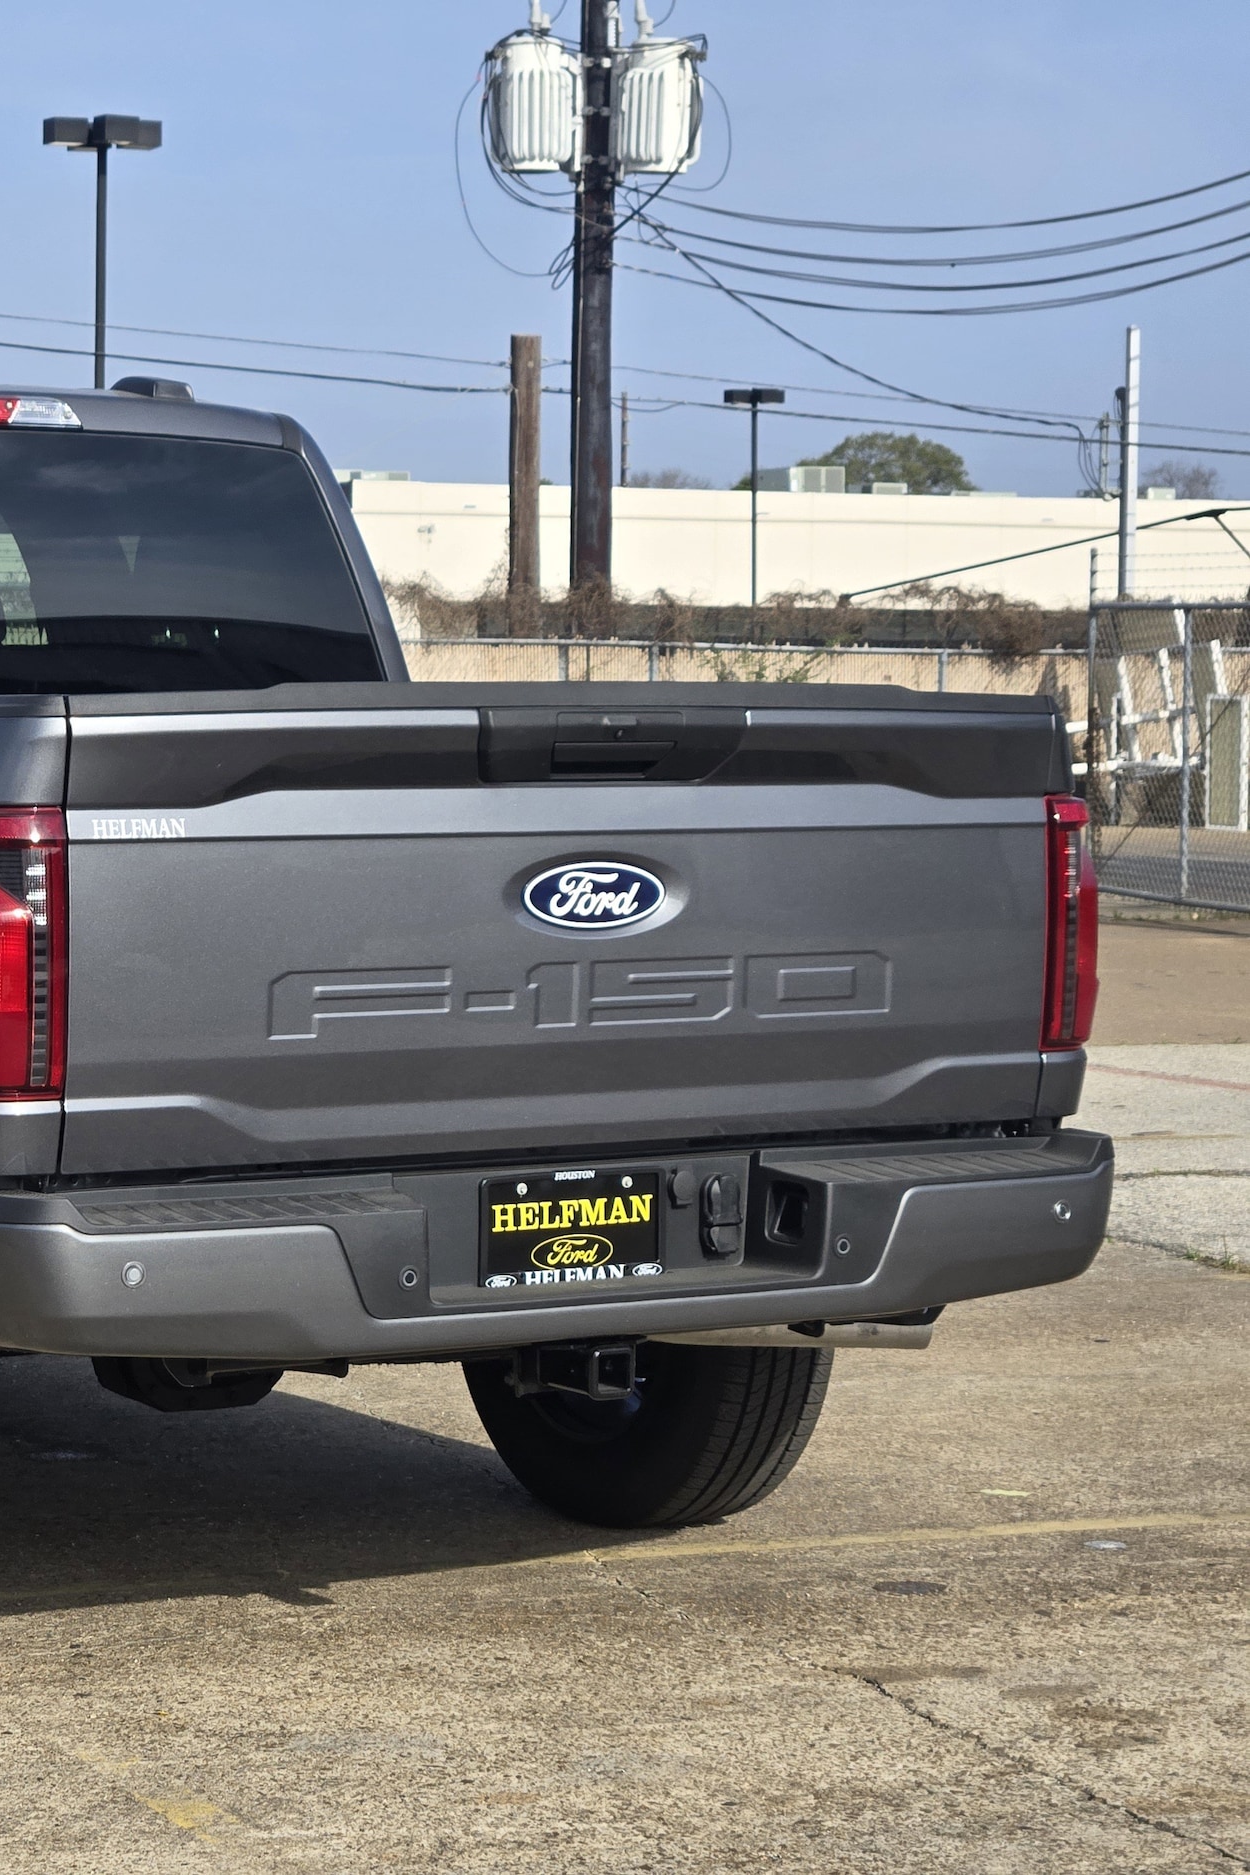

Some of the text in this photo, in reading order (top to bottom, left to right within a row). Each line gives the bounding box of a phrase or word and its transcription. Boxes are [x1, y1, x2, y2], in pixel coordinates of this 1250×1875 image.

[91, 818, 186, 839] HELFMAN
[550, 870, 639, 917] Ford
[266, 949, 893, 1041] F-150
[554, 1170, 596, 1181] HOUSTON
[491, 1194, 653, 1233] HELFMAN
[547, 1239, 599, 1265] Ford
[524, 1264, 626, 1285] HELFMAN
